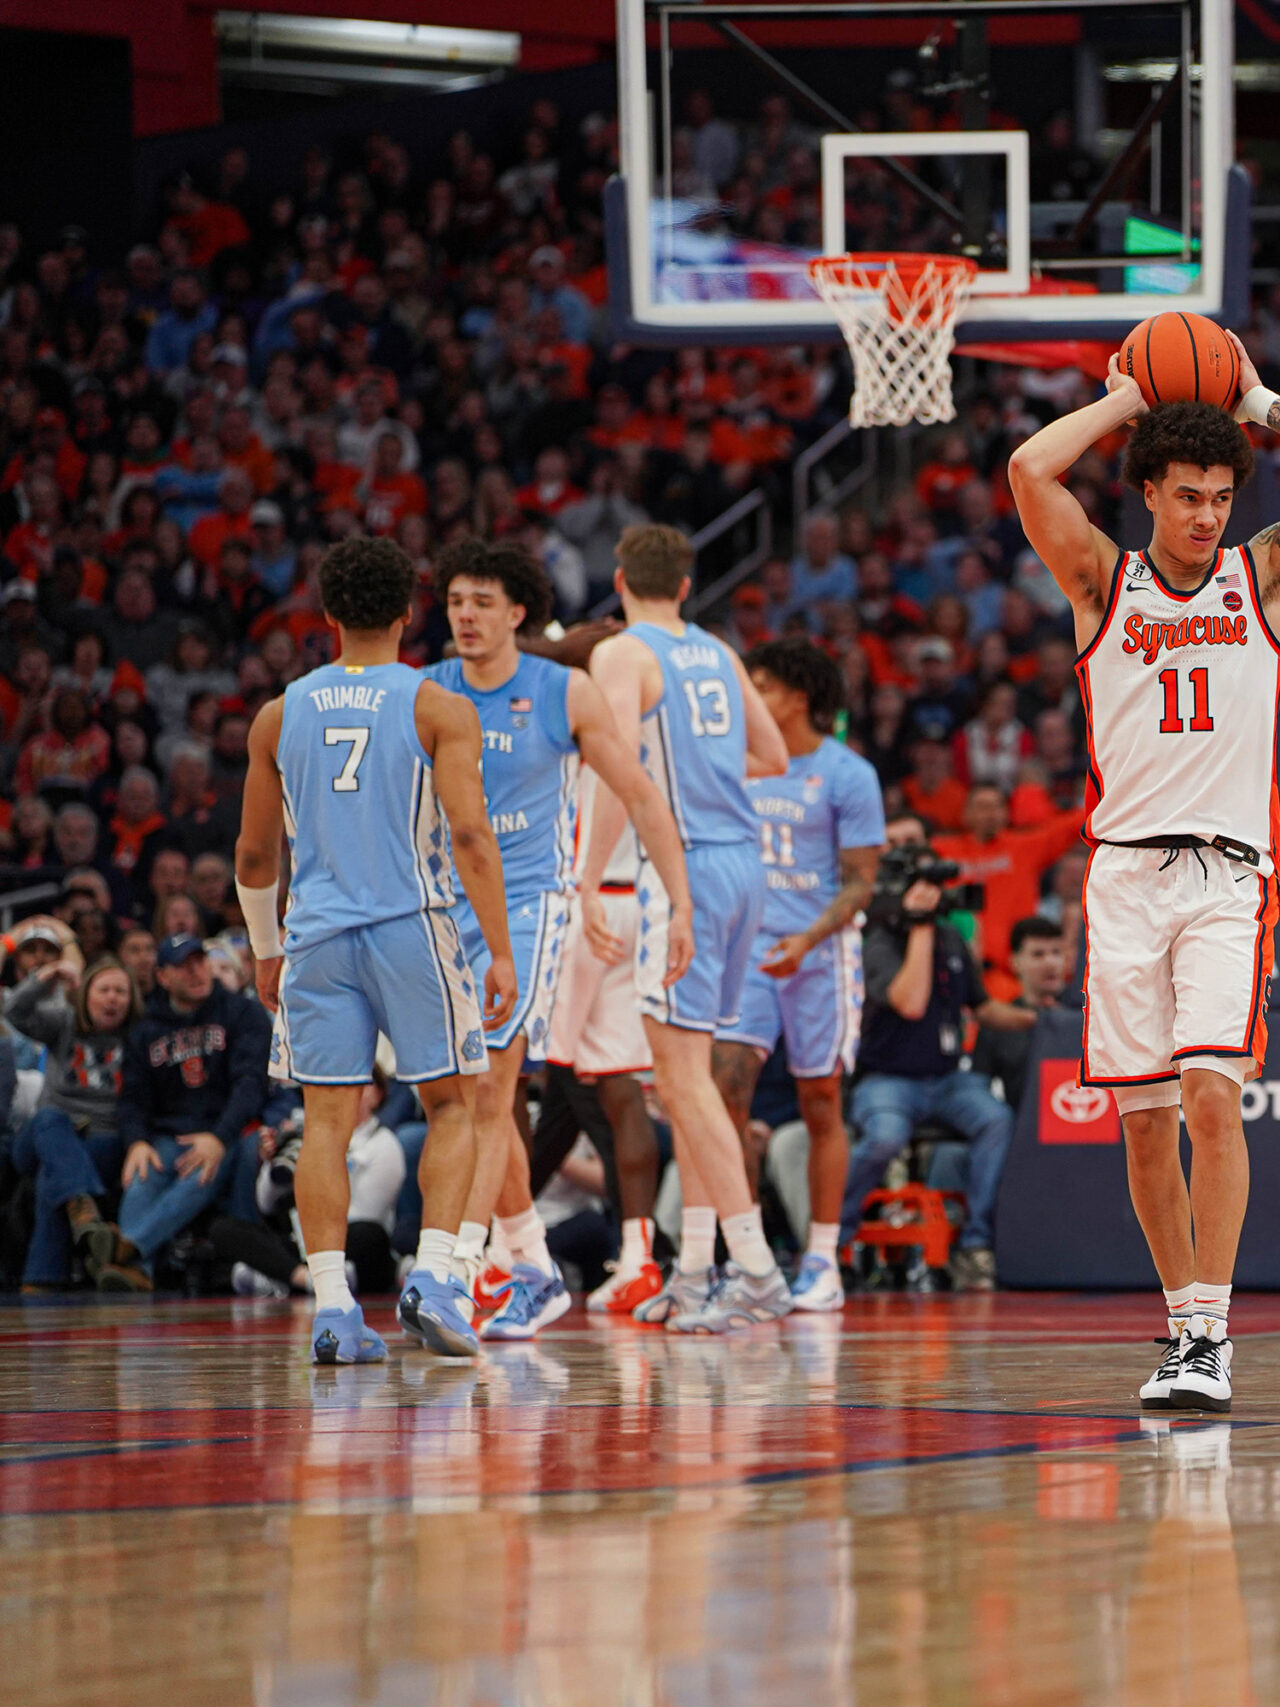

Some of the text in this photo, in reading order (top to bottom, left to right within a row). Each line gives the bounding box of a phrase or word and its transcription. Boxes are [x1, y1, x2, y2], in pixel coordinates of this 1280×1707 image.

[1125, 344, 1135, 379] ACUSE
[1132, 568, 1144, 578] 21
[1135, 562, 1146, 571] LM
[1122, 613, 1248, 666] Syracuse
[309, 685, 387, 713] TRIMBLE
[683, 678, 731, 737] 13
[1158, 667, 1214, 734] 11
[323, 727, 371, 792] 7
[760, 819, 796, 868] 11
